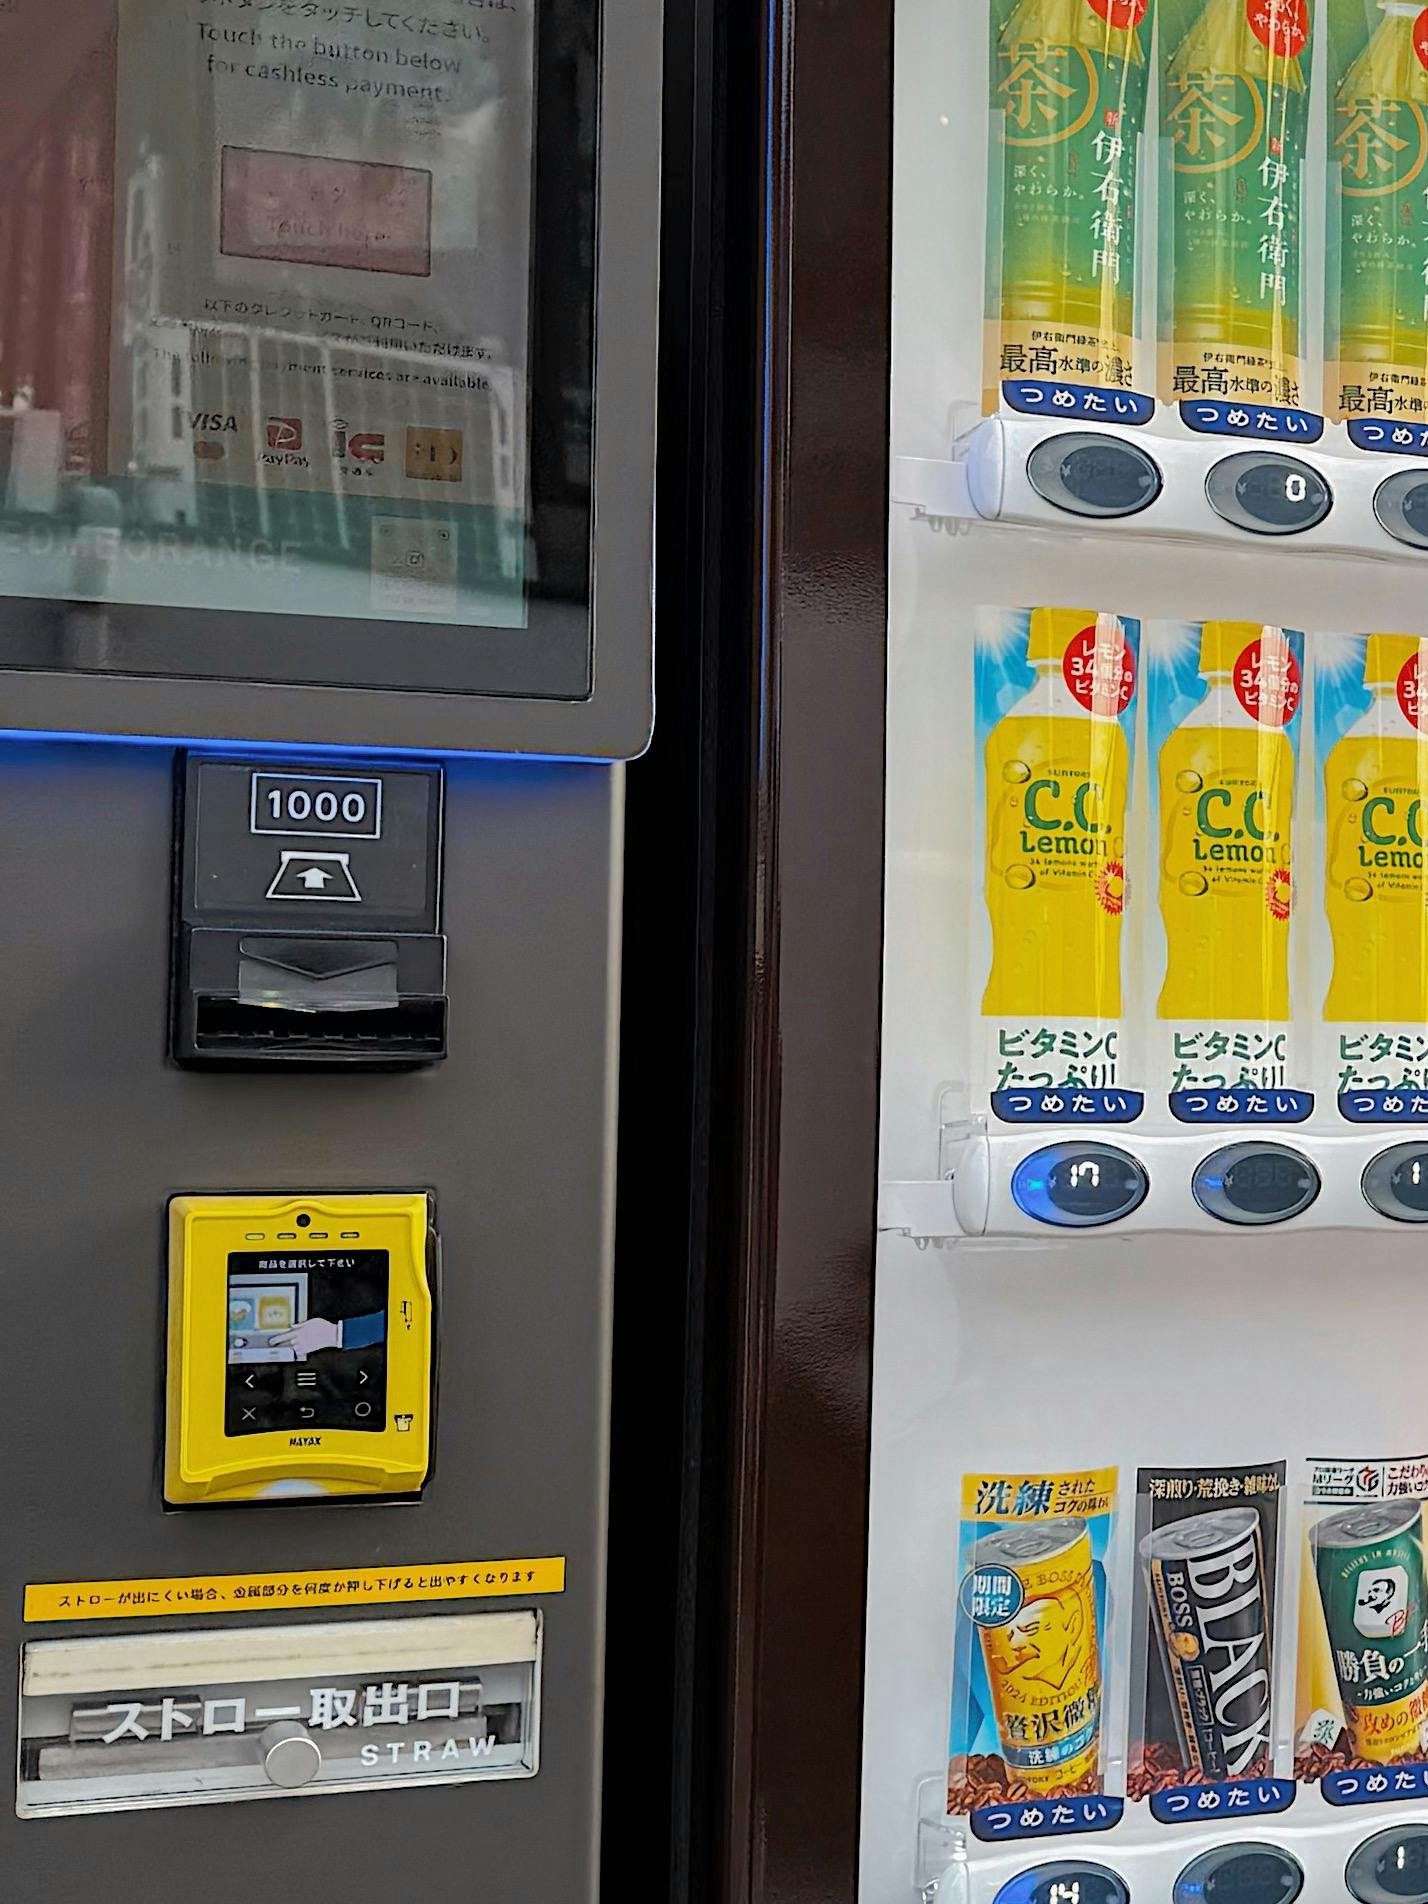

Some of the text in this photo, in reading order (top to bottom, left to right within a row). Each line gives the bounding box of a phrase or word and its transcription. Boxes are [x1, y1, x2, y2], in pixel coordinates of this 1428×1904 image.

[1019, 386, 1138, 415] つめたい
[1196, 406, 1308, 433] つめたい
[266, 789, 366, 824] 1000
[1019, 829, 1108, 858] Lemon
[975, 1480, 1052, 1516] 洗練
[1165, 1571, 1196, 1632] BOSS
[1187, 1535, 1270, 1777] BLACK
[102, 1680, 462, 1745] ストロー取出口
[360, 1734, 497, 1767] STRAW
